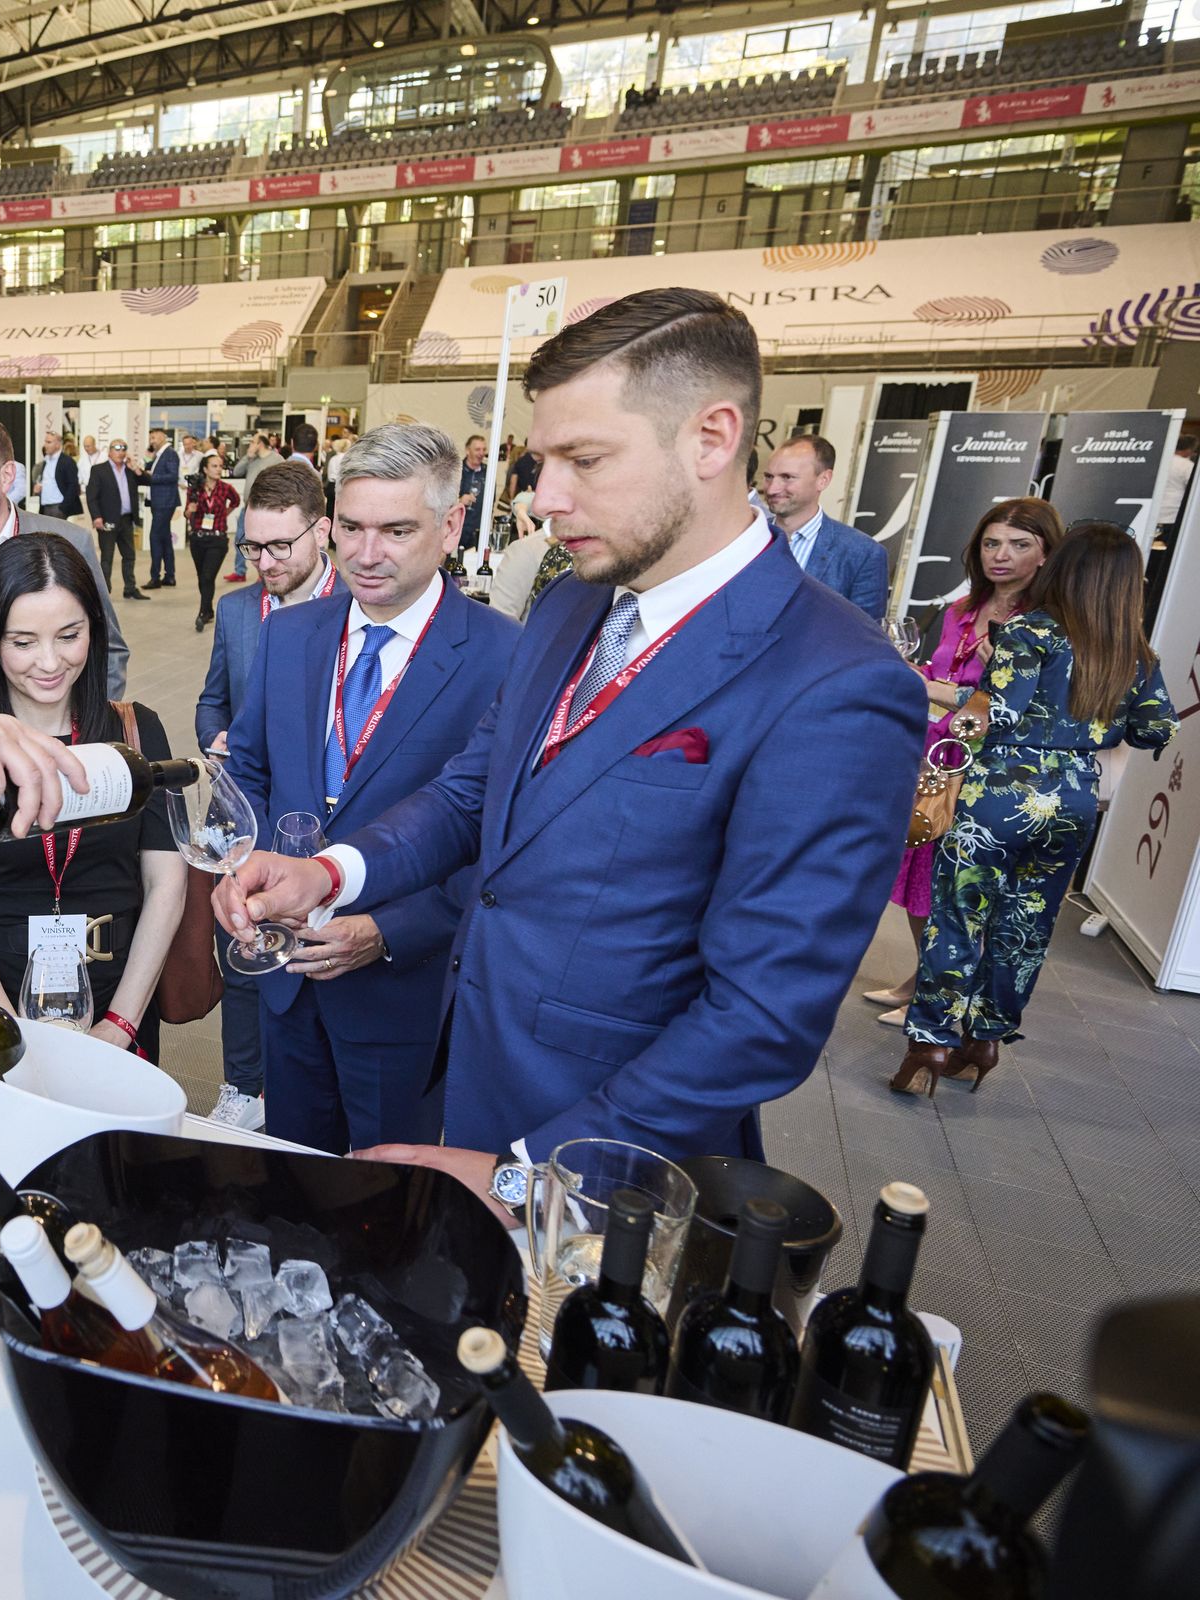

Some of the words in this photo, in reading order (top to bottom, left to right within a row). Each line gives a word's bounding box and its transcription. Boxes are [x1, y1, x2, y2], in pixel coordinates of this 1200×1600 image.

[536, 285, 557, 307] 50
[726, 284, 894, 306] NISTRA
[951, 436, 1029, 453] Jamnica
[1071, 437, 1154, 454] Jamnica
[359, 710, 383, 745] VINISTRA
[547, 698, 571, 747] VINISTR
[67, 827, 81, 861] VINISTR
[41, 926, 76, 934] VINISTRA
